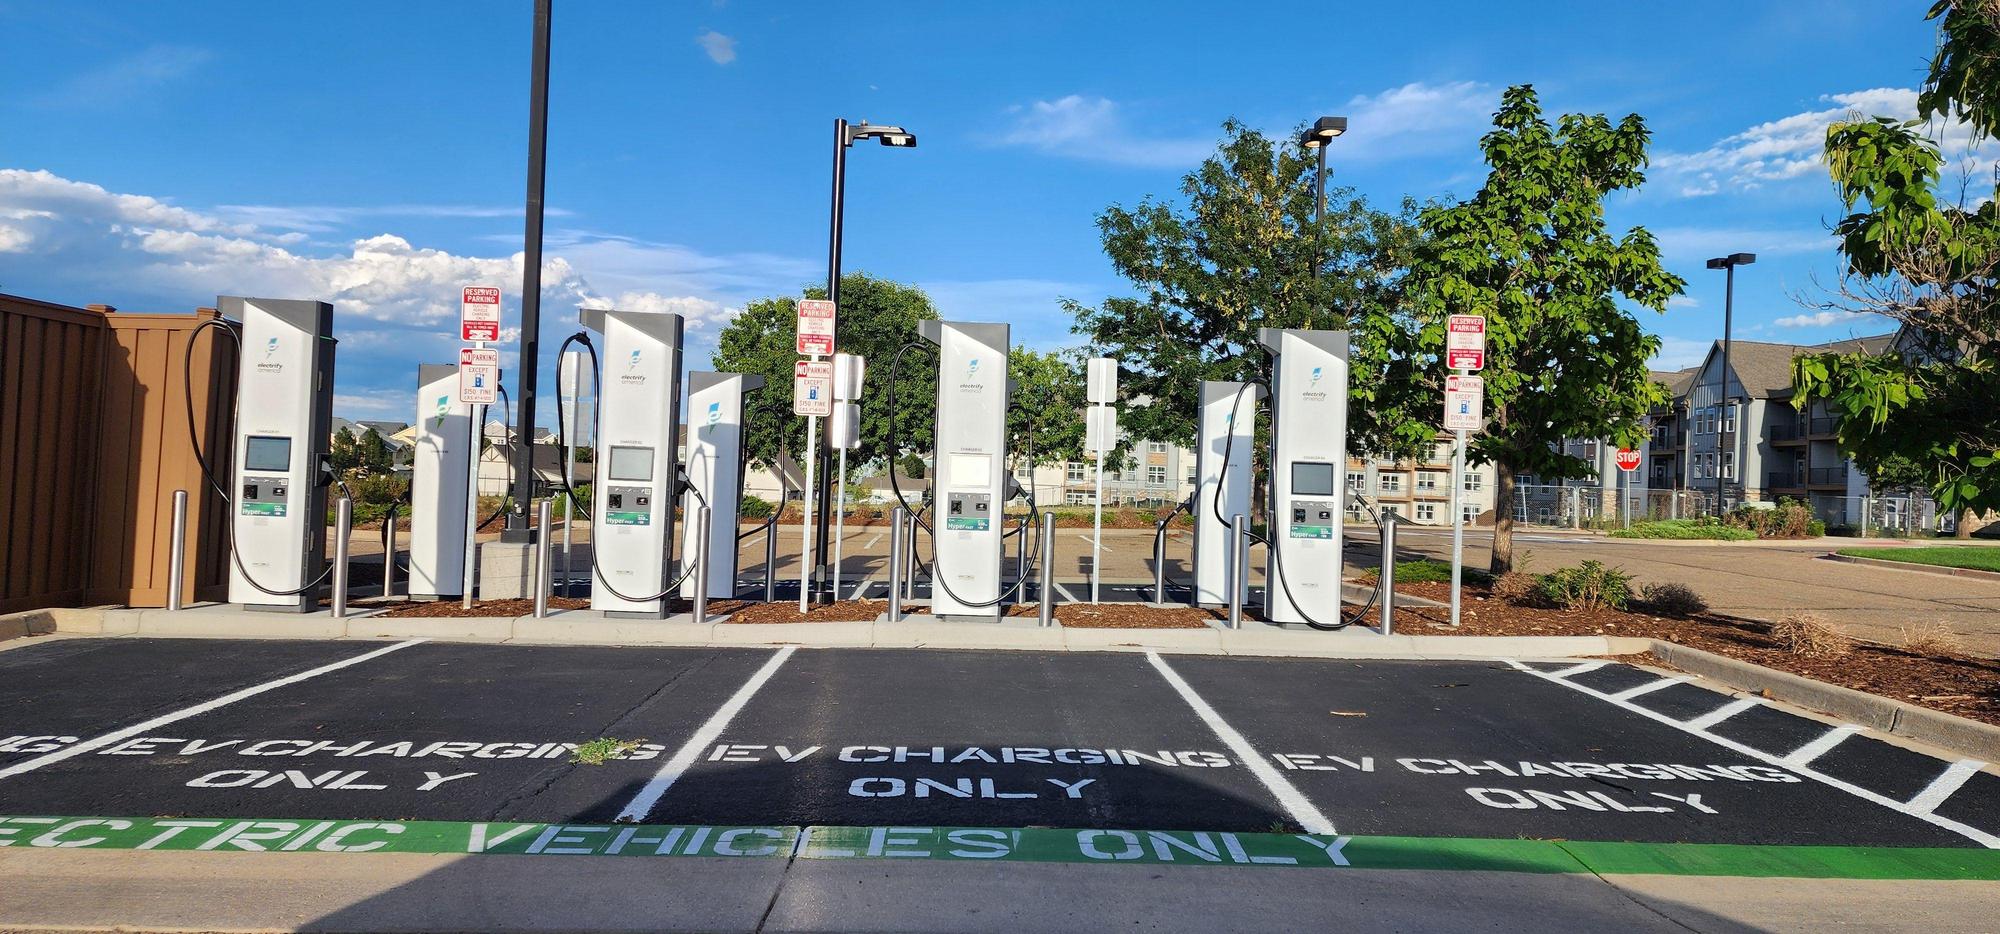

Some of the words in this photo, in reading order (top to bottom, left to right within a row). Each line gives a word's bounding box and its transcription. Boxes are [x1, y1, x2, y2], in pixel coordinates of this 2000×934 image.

[465, 288, 498, 297] RESERVED
[803, 310, 830, 318] PARKING
[1451, 317, 1482, 325] RESERVED
[461, 352, 472, 363] NO
[473, 354, 496, 362] PARKING
[797, 364, 807, 375] NO
[808, 367, 830, 375] PARKING
[1448, 379, 1458, 390] NO
[1617, 452, 1640, 463] STOP
[0, 735, 79, 753] G
[97, 737, 245, 756] EV
[708, 745, 822, 763] EV
[838, 746, 1232, 768] CHARGING
[1272, 753, 1375, 773] EV
[1396, 757, 1801, 783] CHARGING
[186, 769, 478, 791] ONLY
[848, 777, 1096, 799] ONLY
[1465, 787, 1719, 815] ONLY
[467, 823, 1010, 858] VEHICLES
[1076, 829, 1352, 866] ONLY
